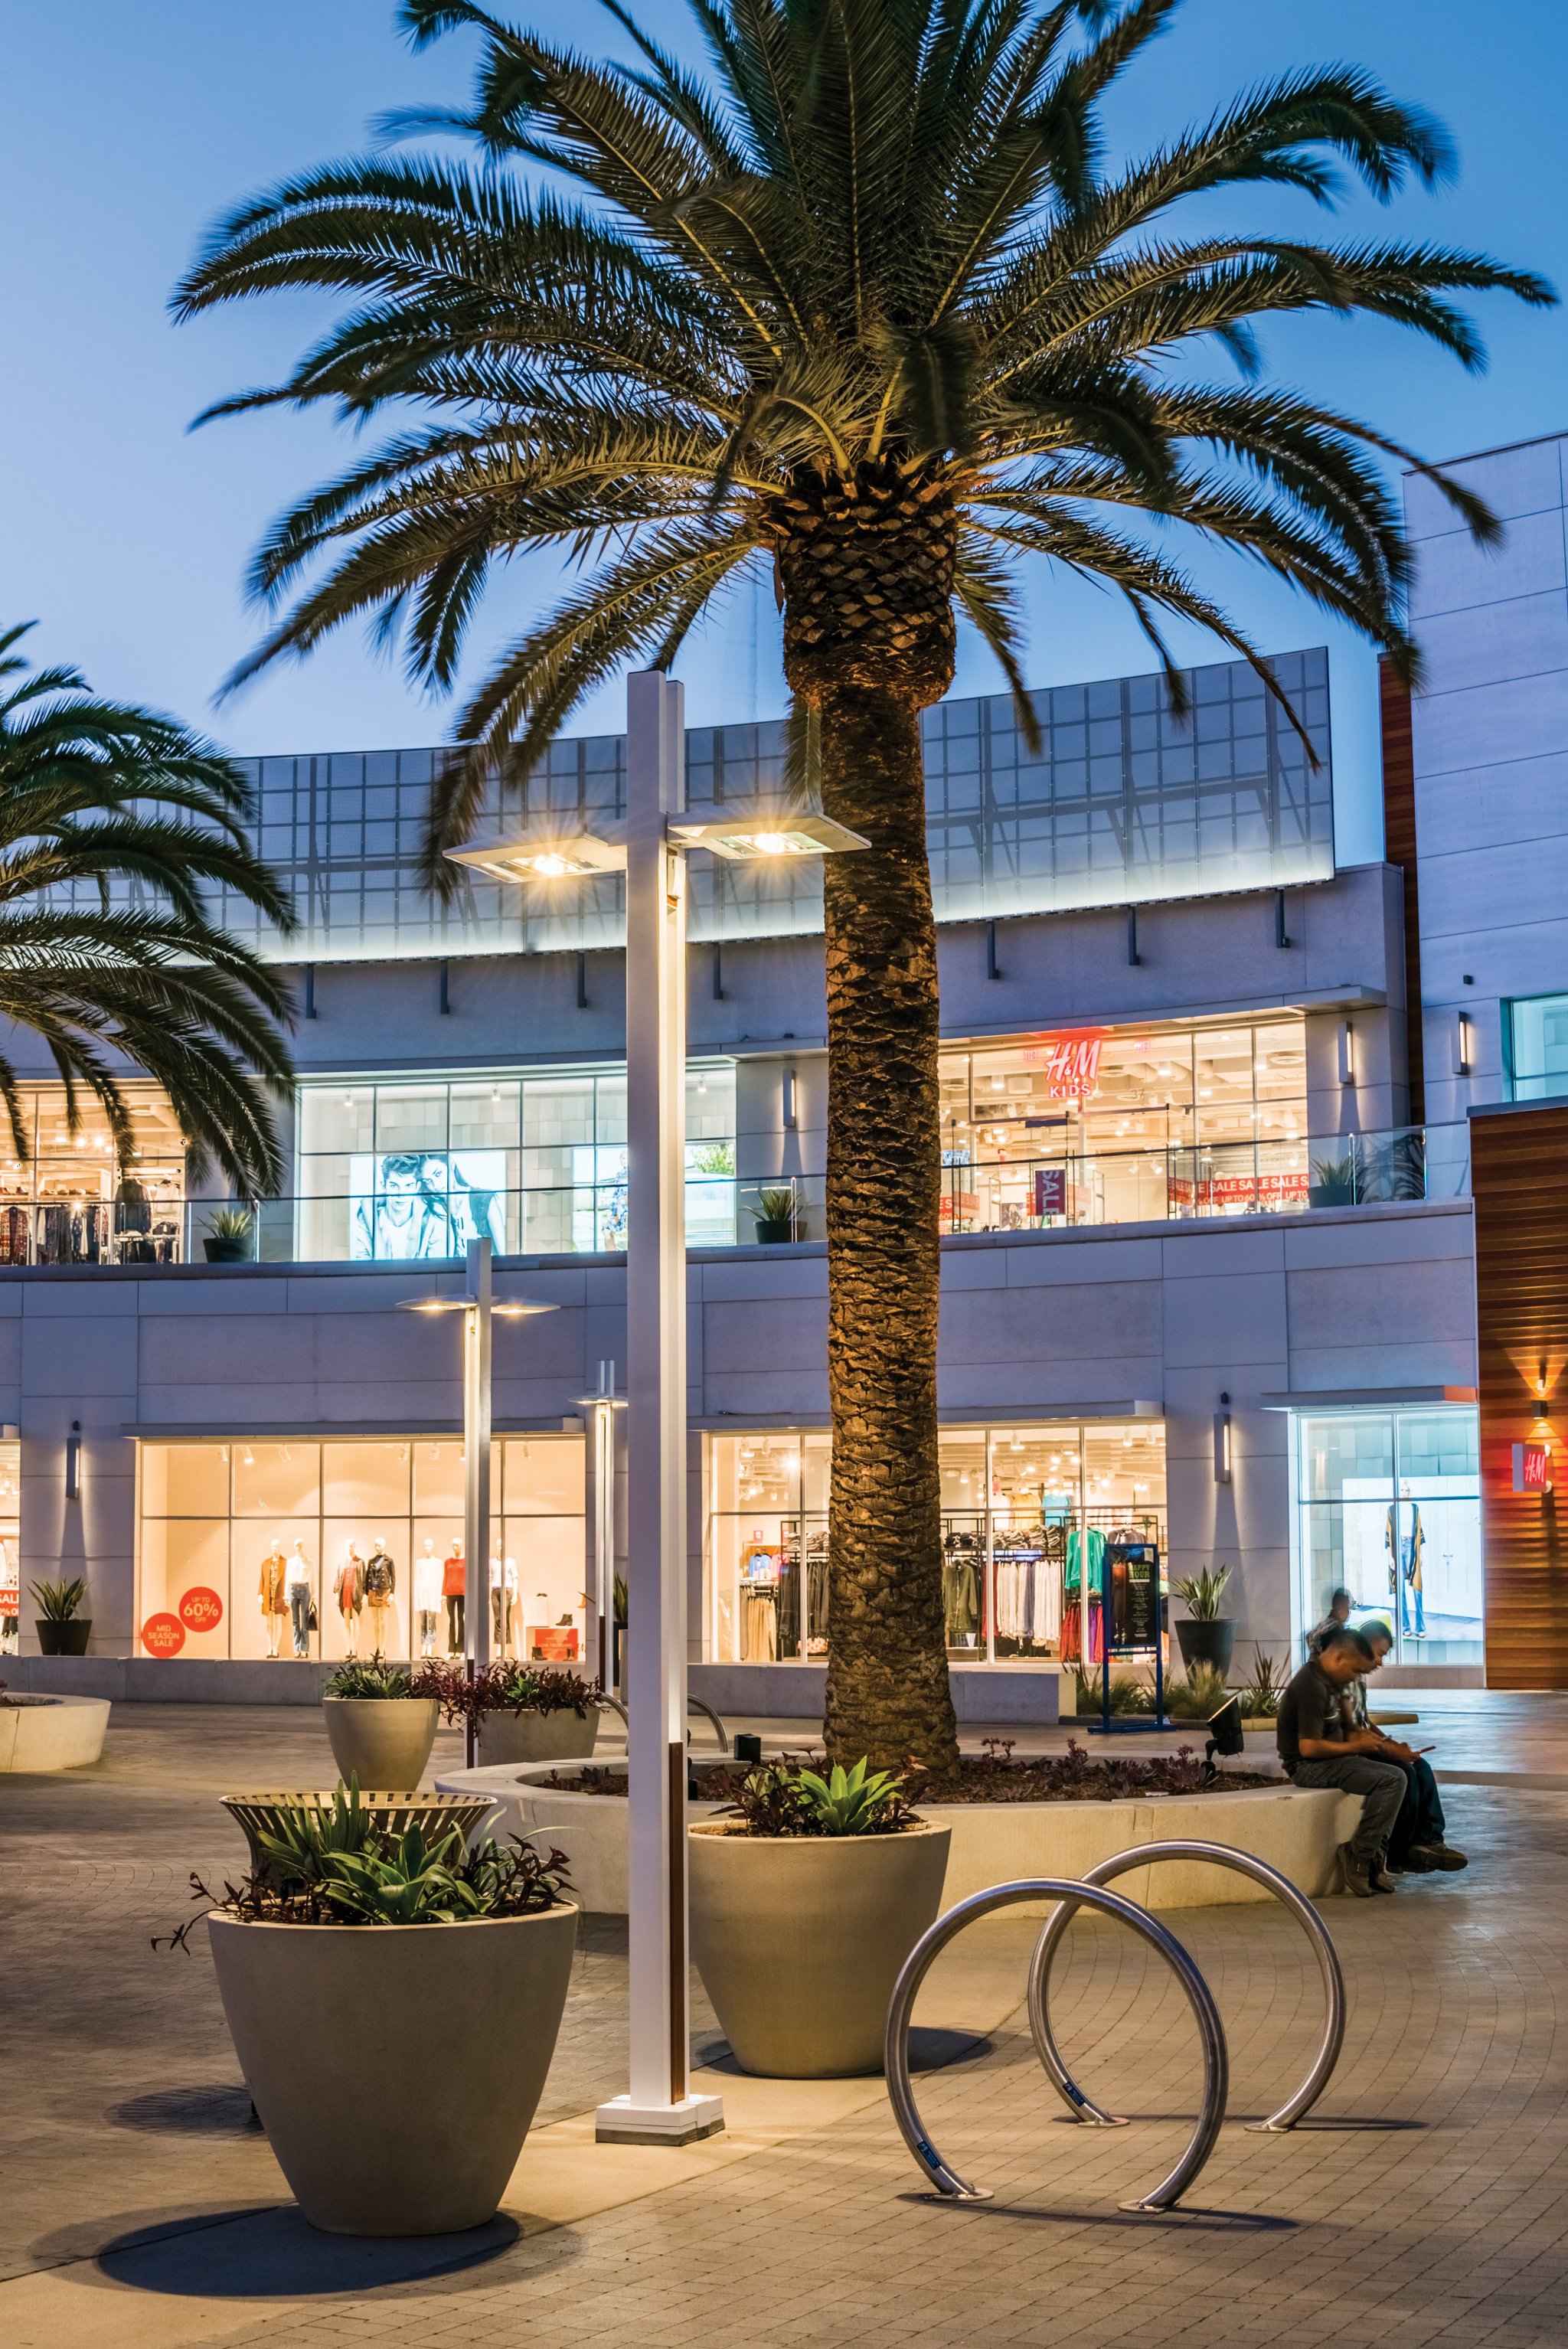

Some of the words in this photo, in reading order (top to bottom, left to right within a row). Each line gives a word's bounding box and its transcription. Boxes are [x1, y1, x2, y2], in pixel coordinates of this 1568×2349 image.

[1046, 1040, 1100, 1081] H&M
[1050, 1083, 1091, 1098] KIDS
[1042, 1171, 1060, 1215] SALE
[1210, 1181, 1237, 1193] SALE
[1271, 1175, 1298, 1188] SALE
[1221, 1194, 1232, 1203] UP
[1285, 1191, 1296, 1200] UP
[1297, 1190, 1308, 1198] TO
[1524, 1453, 1546, 1483] H&M
[184, 1603, 219, 1617] 60%
